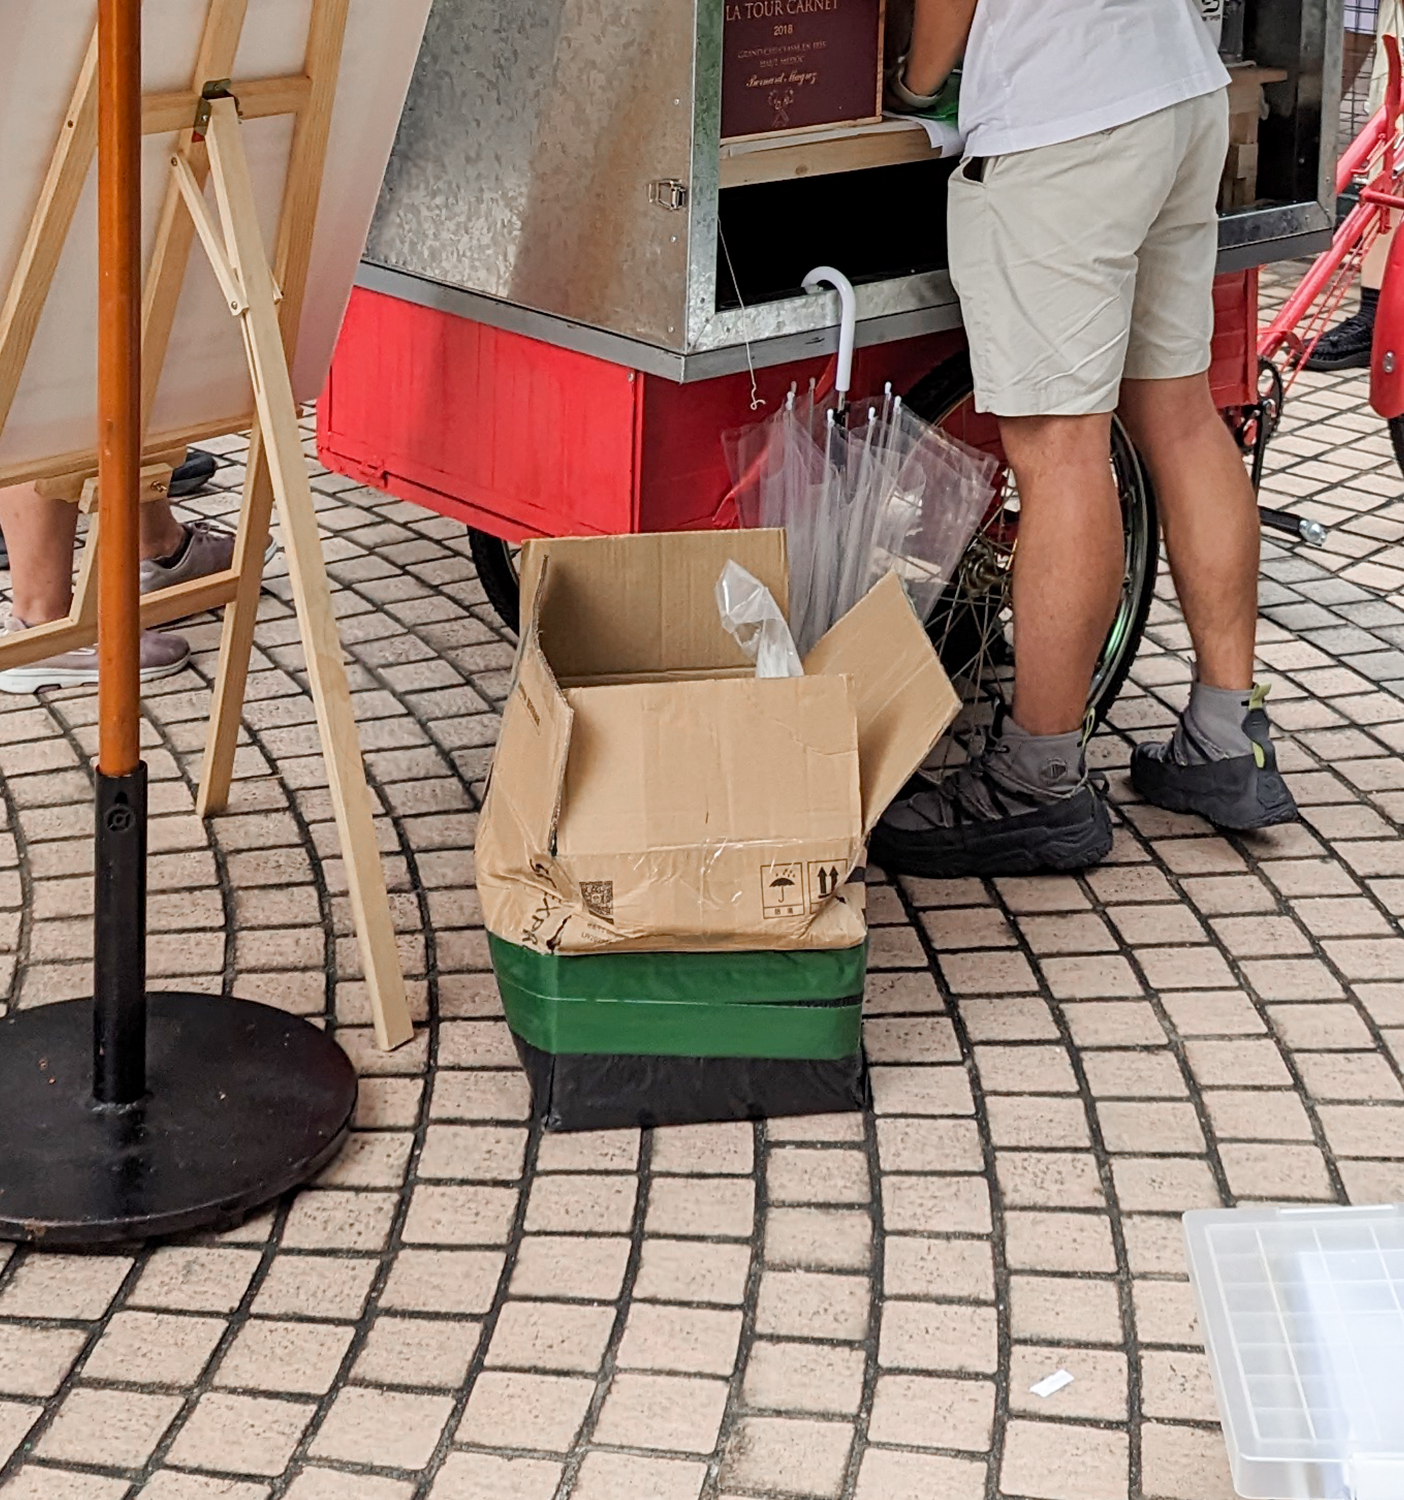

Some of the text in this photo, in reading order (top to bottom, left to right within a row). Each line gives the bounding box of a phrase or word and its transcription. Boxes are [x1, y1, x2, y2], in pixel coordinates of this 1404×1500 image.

[726, 5, 742, 21] LA
[745, 1, 784, 19] TOUR
[773, 24, 793, 36] 2018
